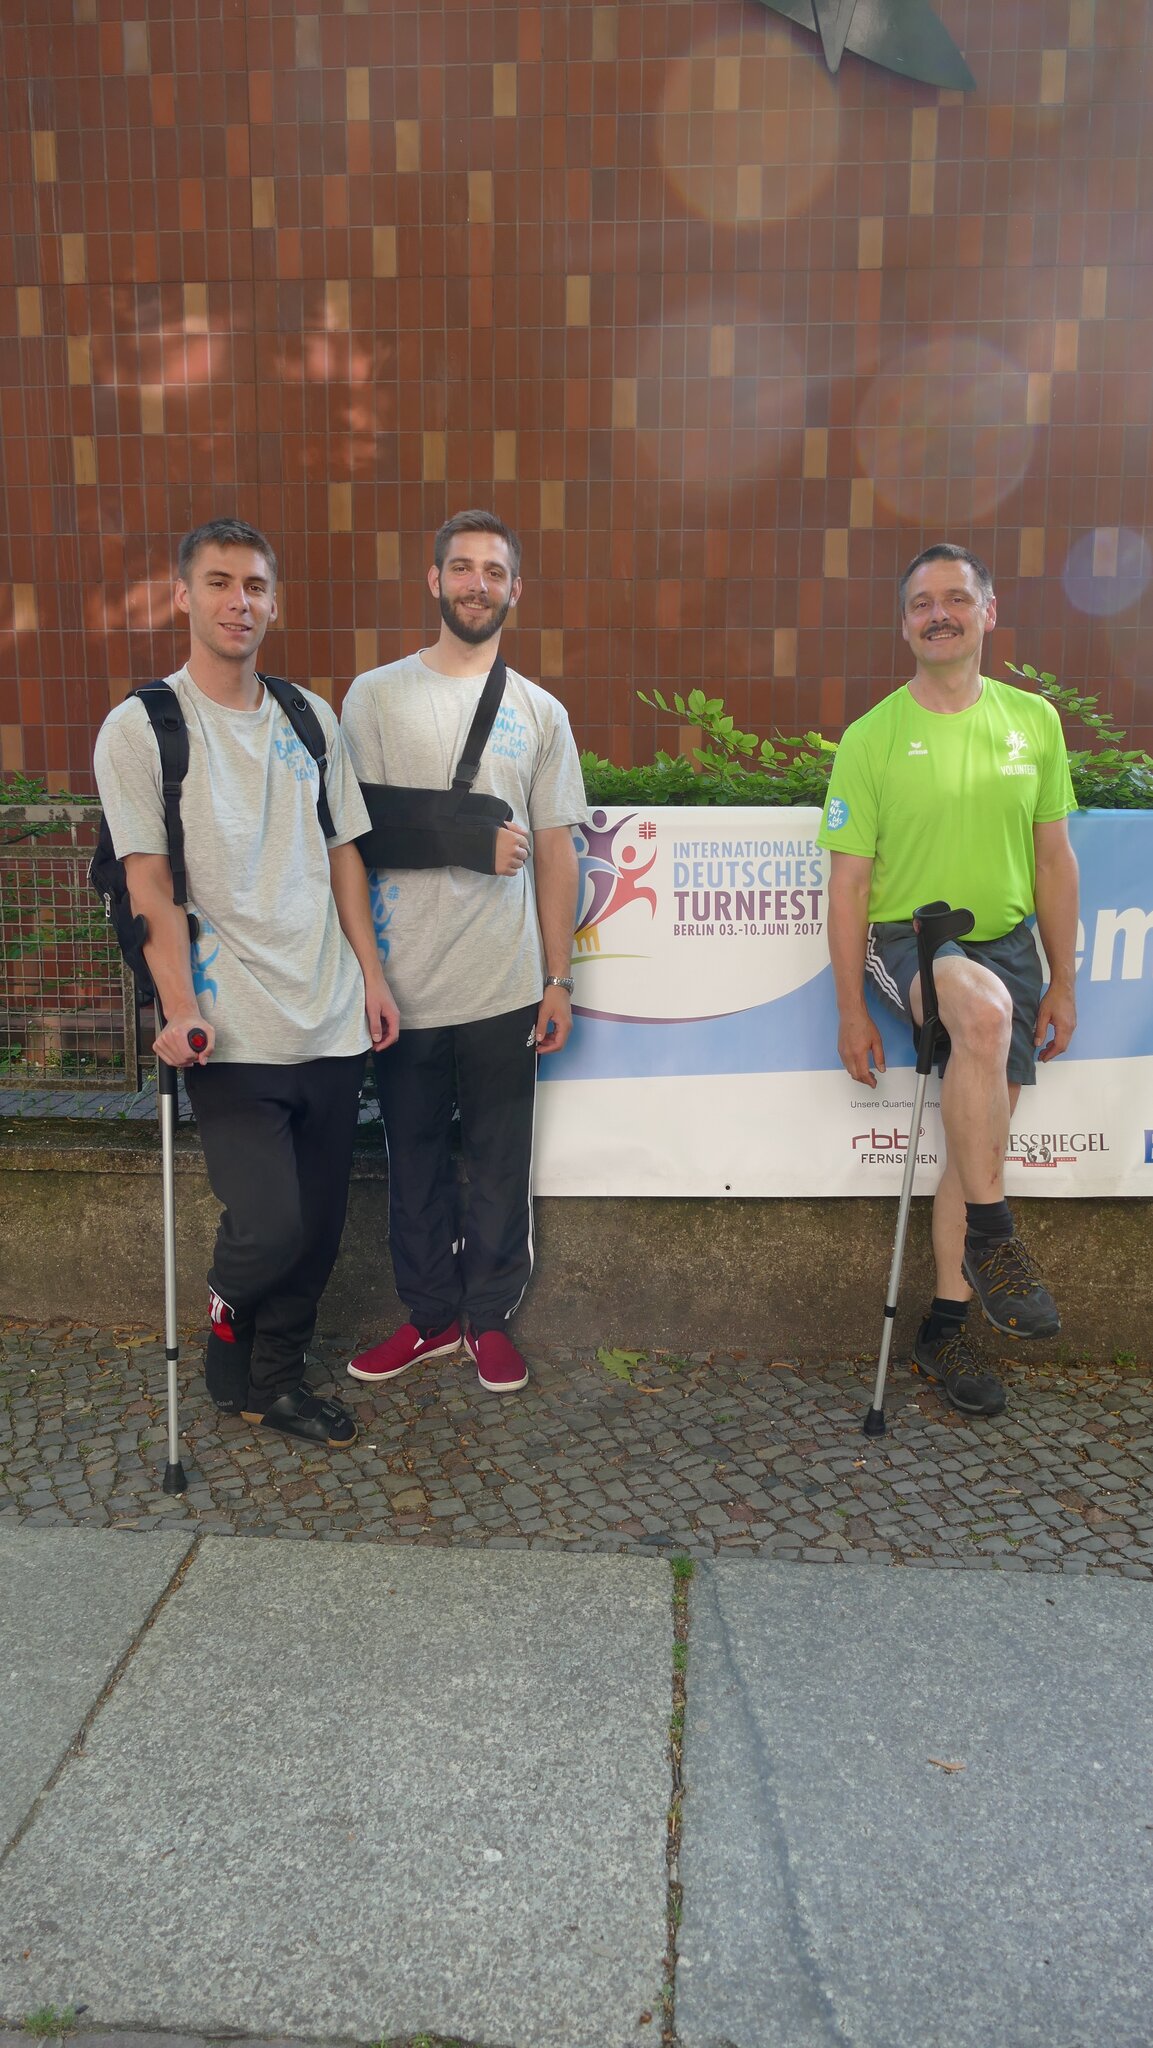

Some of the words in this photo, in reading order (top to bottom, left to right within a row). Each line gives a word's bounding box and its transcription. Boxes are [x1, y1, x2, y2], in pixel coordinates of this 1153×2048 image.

[674, 841, 823, 858] INTERNATIONALES
[674, 860, 823, 888] DEUTSCHES
[674, 890, 823, 921] TURNFEST
[674, 924, 714, 936] BERLIN
[794, 923, 823, 935] 2017
[1007, 1133, 1110, 1152] ESSPIEGEL
